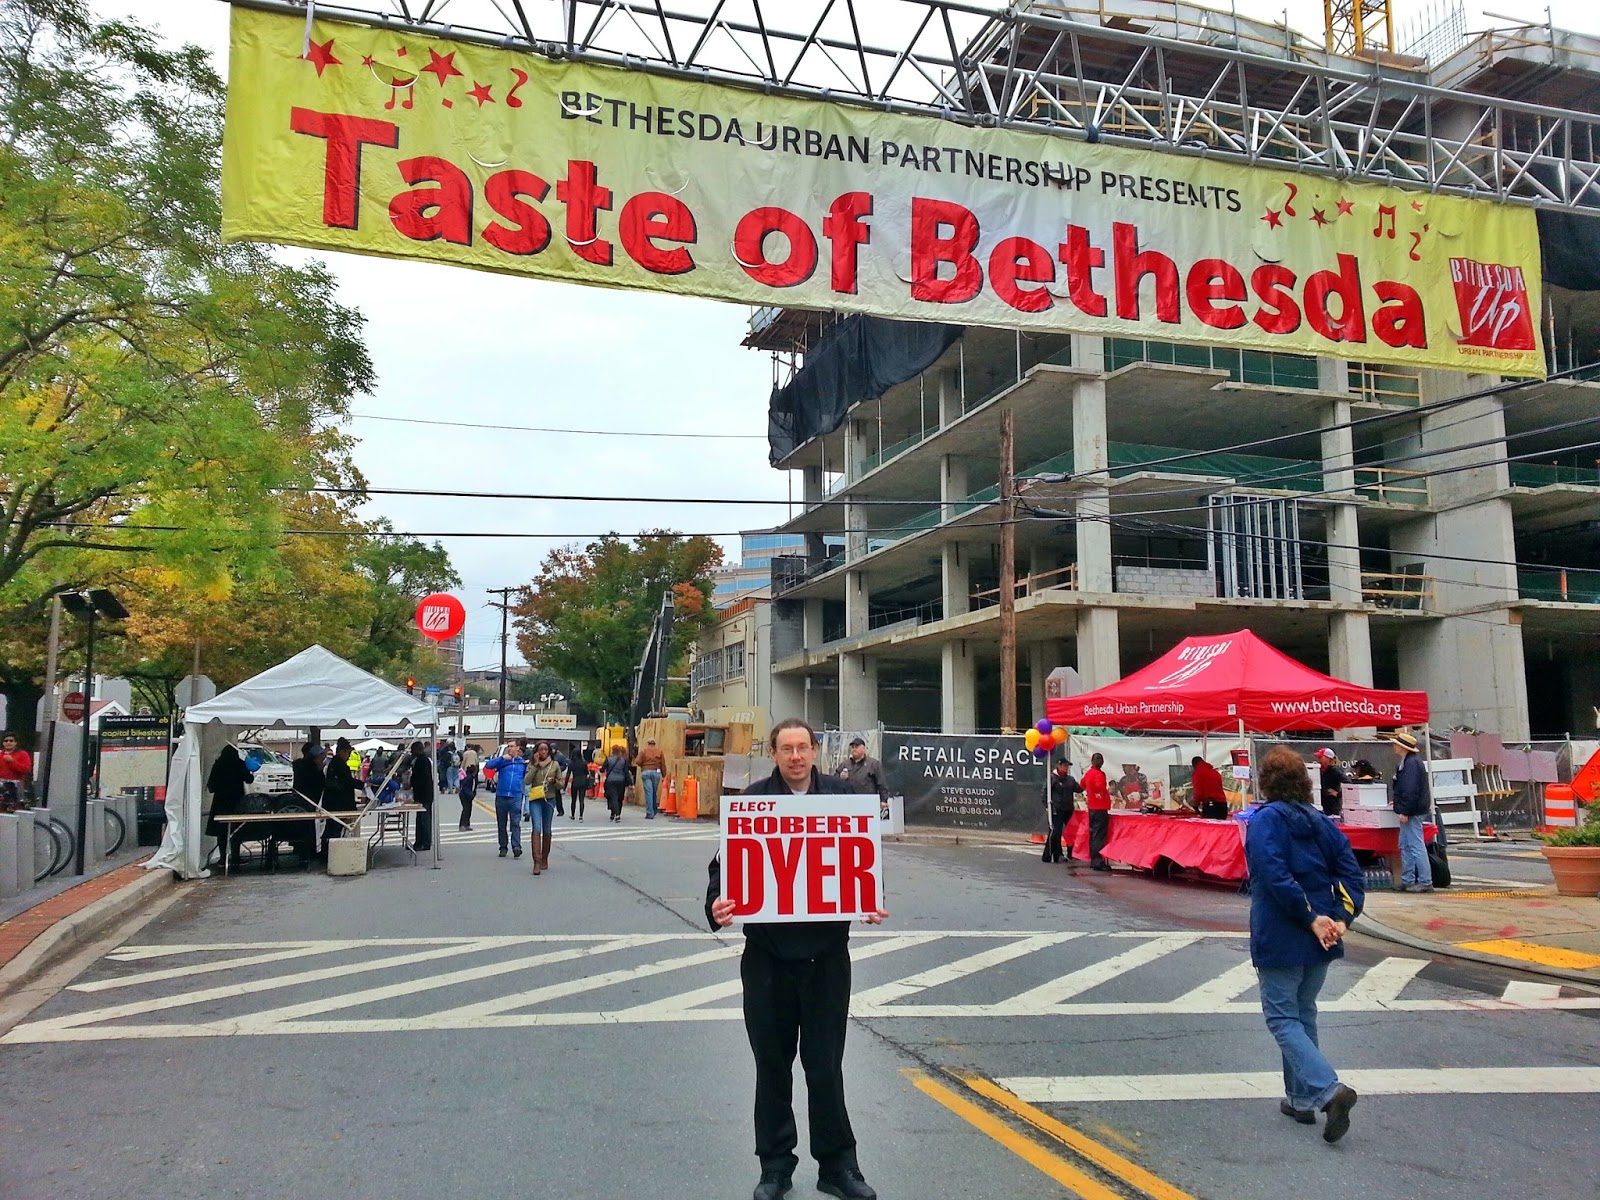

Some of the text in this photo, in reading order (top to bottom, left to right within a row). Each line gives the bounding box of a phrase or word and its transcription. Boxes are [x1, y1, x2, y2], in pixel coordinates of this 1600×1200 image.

[561, 91, 1242, 212] BETHESDA URBAN PARTNERSHIP PRESENTS
[290, 106, 1428, 349] Taste of Bethesda
[1084, 701, 1184, 716] Bethesda Urban Partnership
[1270, 696, 1402, 720] www.bethesda.org
[102, 728, 167, 738] capital bikeshare
[898, 745, 967, 763] RETAIL
[923, 765, 1014, 781] AVAILABLE
[941, 786, 995, 797] STEVE GAUDIO
[729, 801, 776, 812] ELECT
[935, 805, 1002, 816] RETAIL@JBG.COM
[727, 816, 874, 835] ROBERT
[726, 837, 878, 916] DYER
